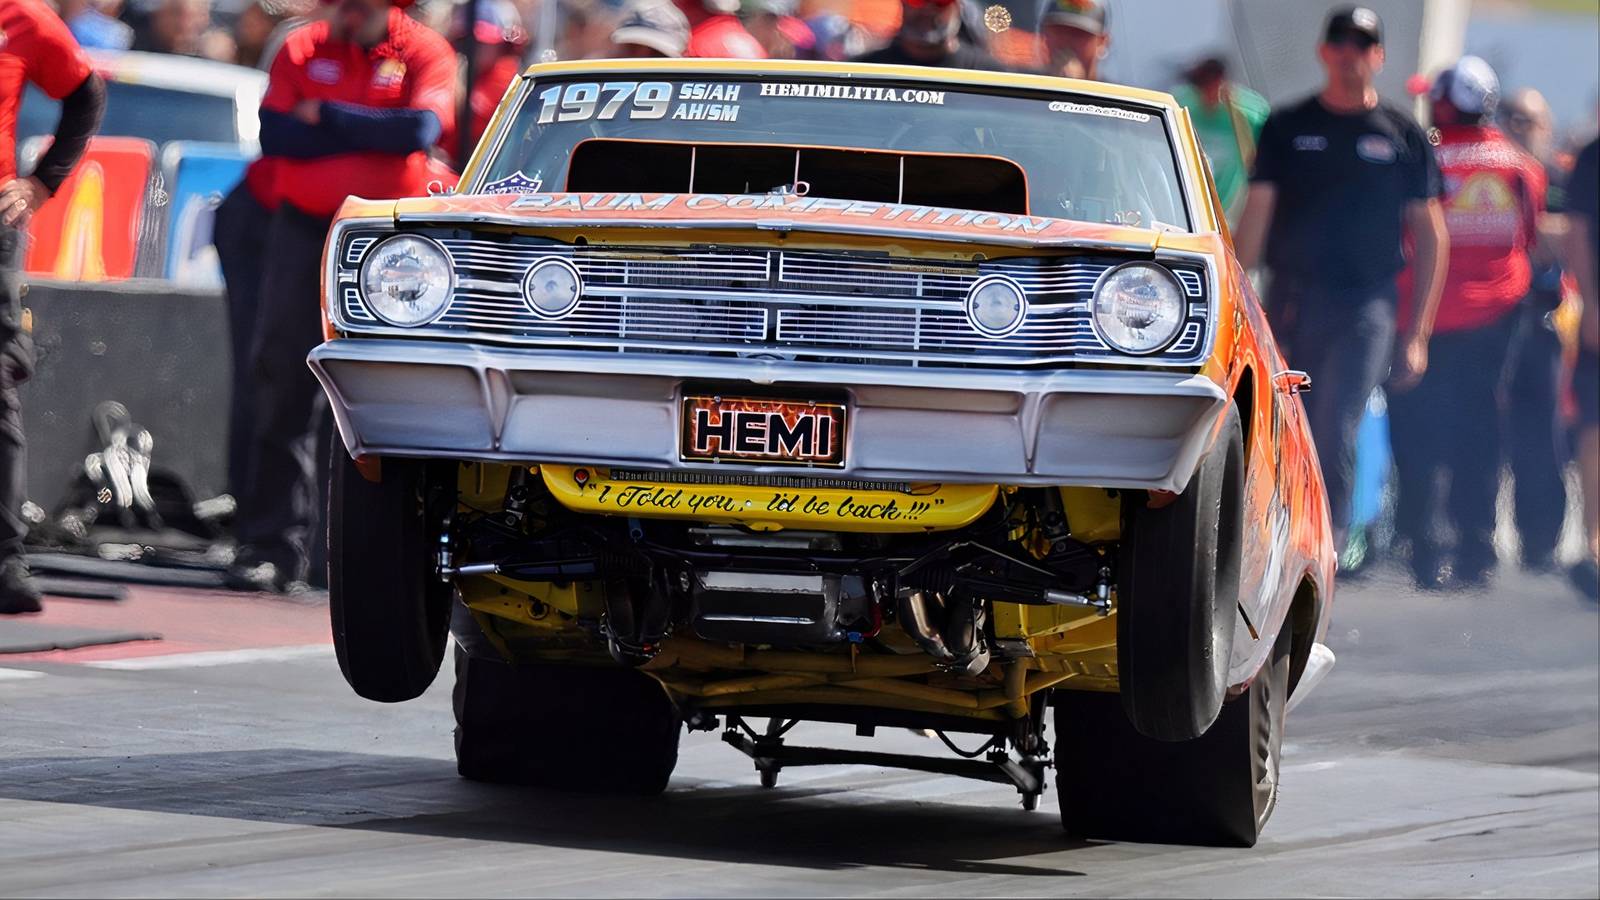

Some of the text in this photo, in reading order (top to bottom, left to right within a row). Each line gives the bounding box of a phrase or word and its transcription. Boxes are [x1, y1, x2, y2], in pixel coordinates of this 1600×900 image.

[537, 82, 672, 124] 1979
[679, 83, 741, 101] SS/AH
[760, 83, 945, 105] HEMIMILITIA.COM
[672, 103, 740, 122] AH/SM
[505, 194, 1053, 234] BAUM COMPETITION
[695, 409, 832, 457] HEMI
[616, 485, 683, 509] Told
[803, 495, 830, 515] be
